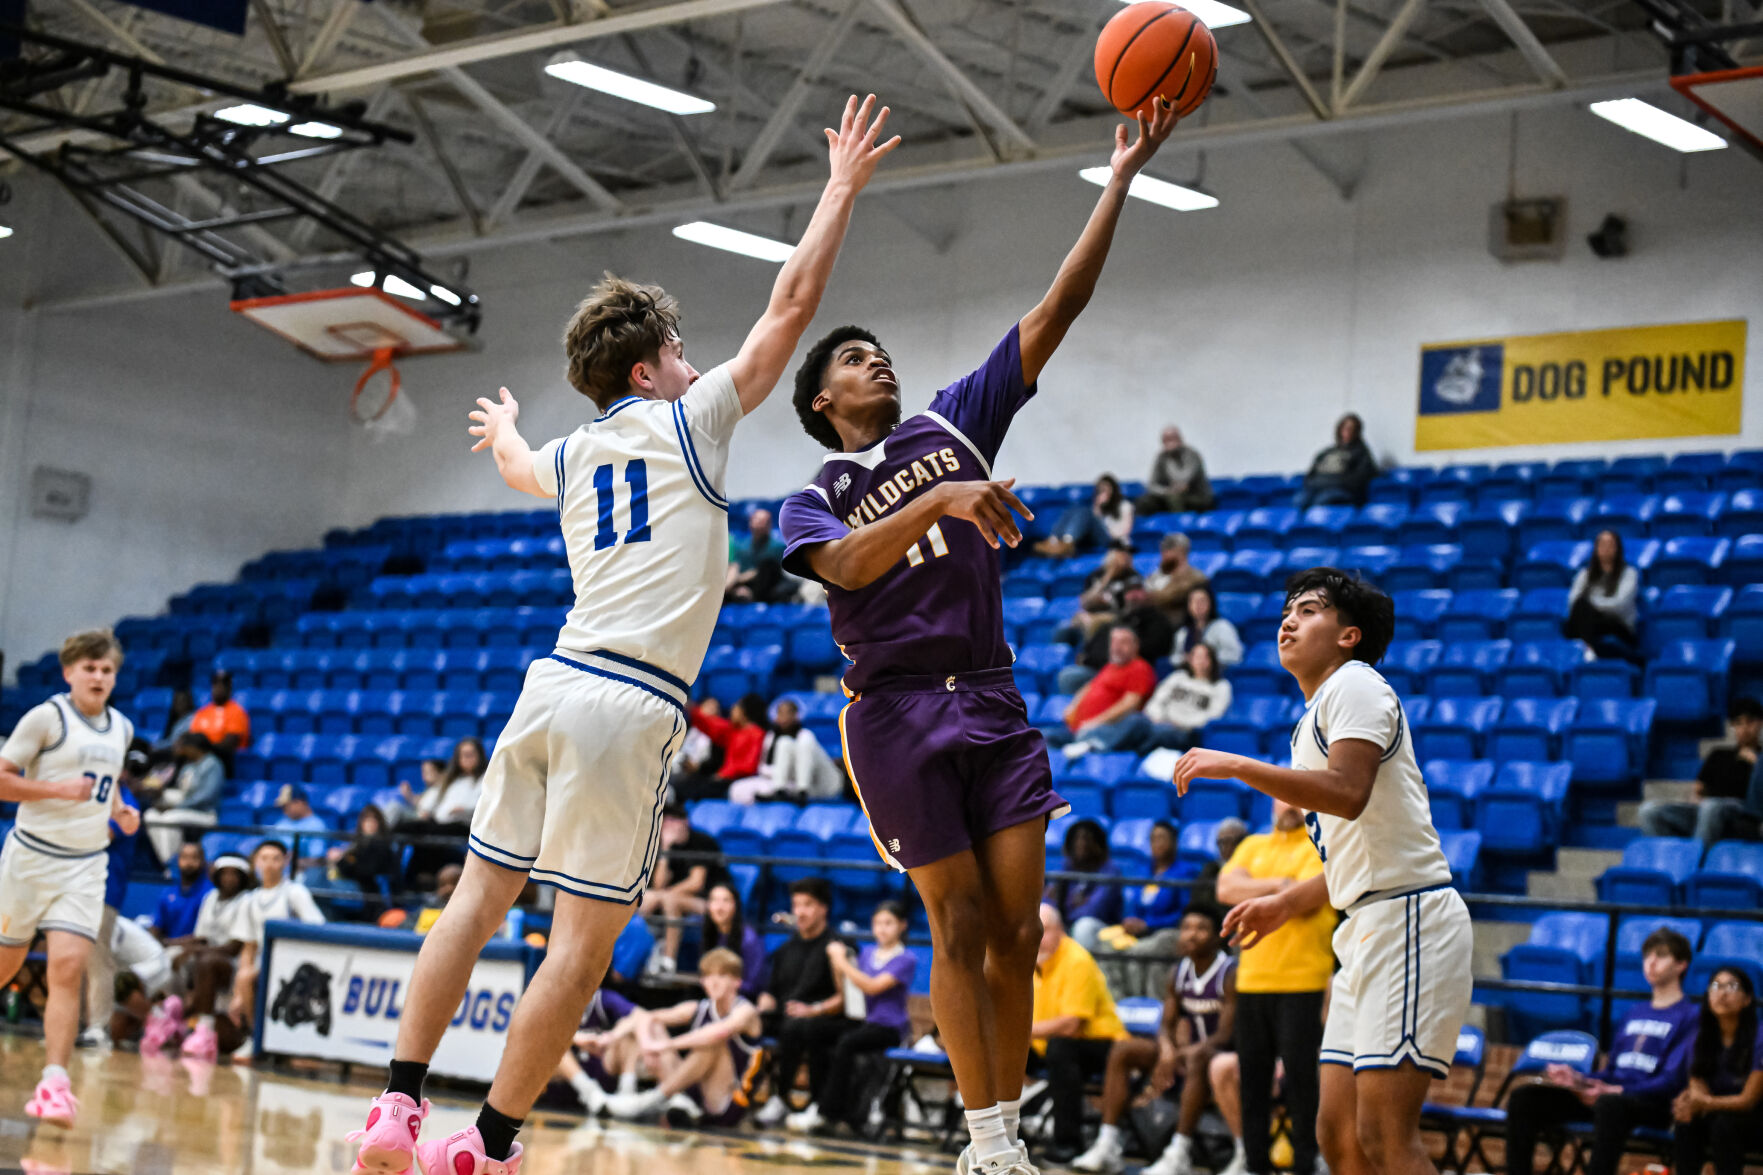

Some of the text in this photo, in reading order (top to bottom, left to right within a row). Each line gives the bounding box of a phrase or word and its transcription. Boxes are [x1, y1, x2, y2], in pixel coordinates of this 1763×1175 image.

[1512, 351, 1734, 403] DOG POUND
[593, 458, 651, 551] 11
[844, 447, 961, 530] WILDCATS
[342, 974, 515, 1033] BULOGS
